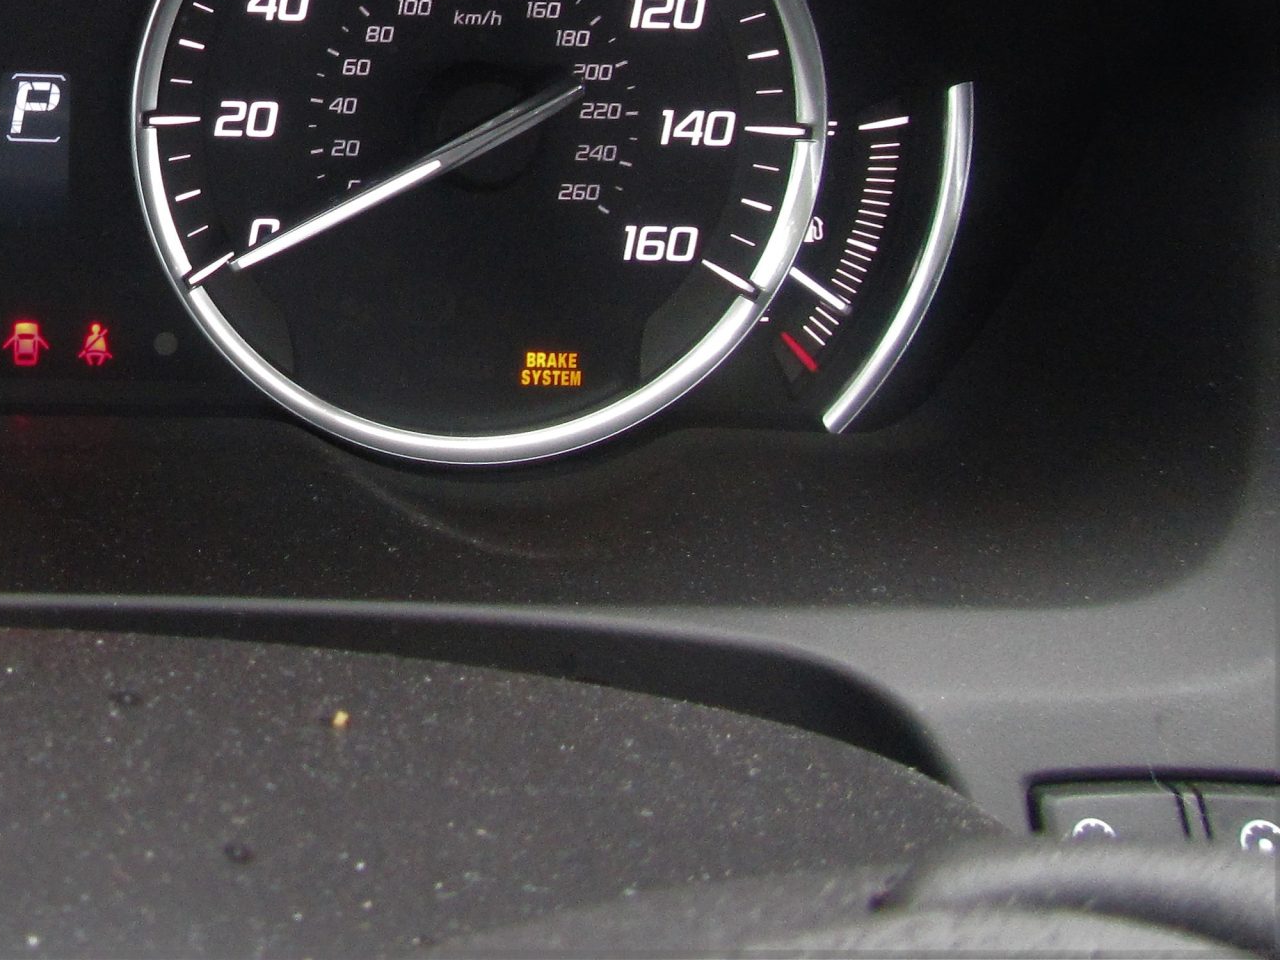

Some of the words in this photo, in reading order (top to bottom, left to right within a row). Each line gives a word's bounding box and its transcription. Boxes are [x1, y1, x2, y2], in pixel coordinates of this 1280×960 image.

[453, 10, 502, 26] km/h
[527, 1, 562, 19] 160
[365, 25, 395, 43] 80
[556, 29, 591, 47] 180
[342, 58, 371, 76] 60
[573, 63, 613, 81] 200
[10, 80, 61, 134] P
[328, 97, 358, 114] 40
[579, 102, 622, 120] 220
[213, 100, 279, 138] 20
[660, 109, 737, 147] 140
[331, 139, 361, 157] 20
[575, 144, 618, 162] 240
[557, 183, 601, 201] 260
[623, 225, 699, 262] 160
[526, 352, 578, 369] BRAKE
[521, 369, 582, 386] SYSTEM
